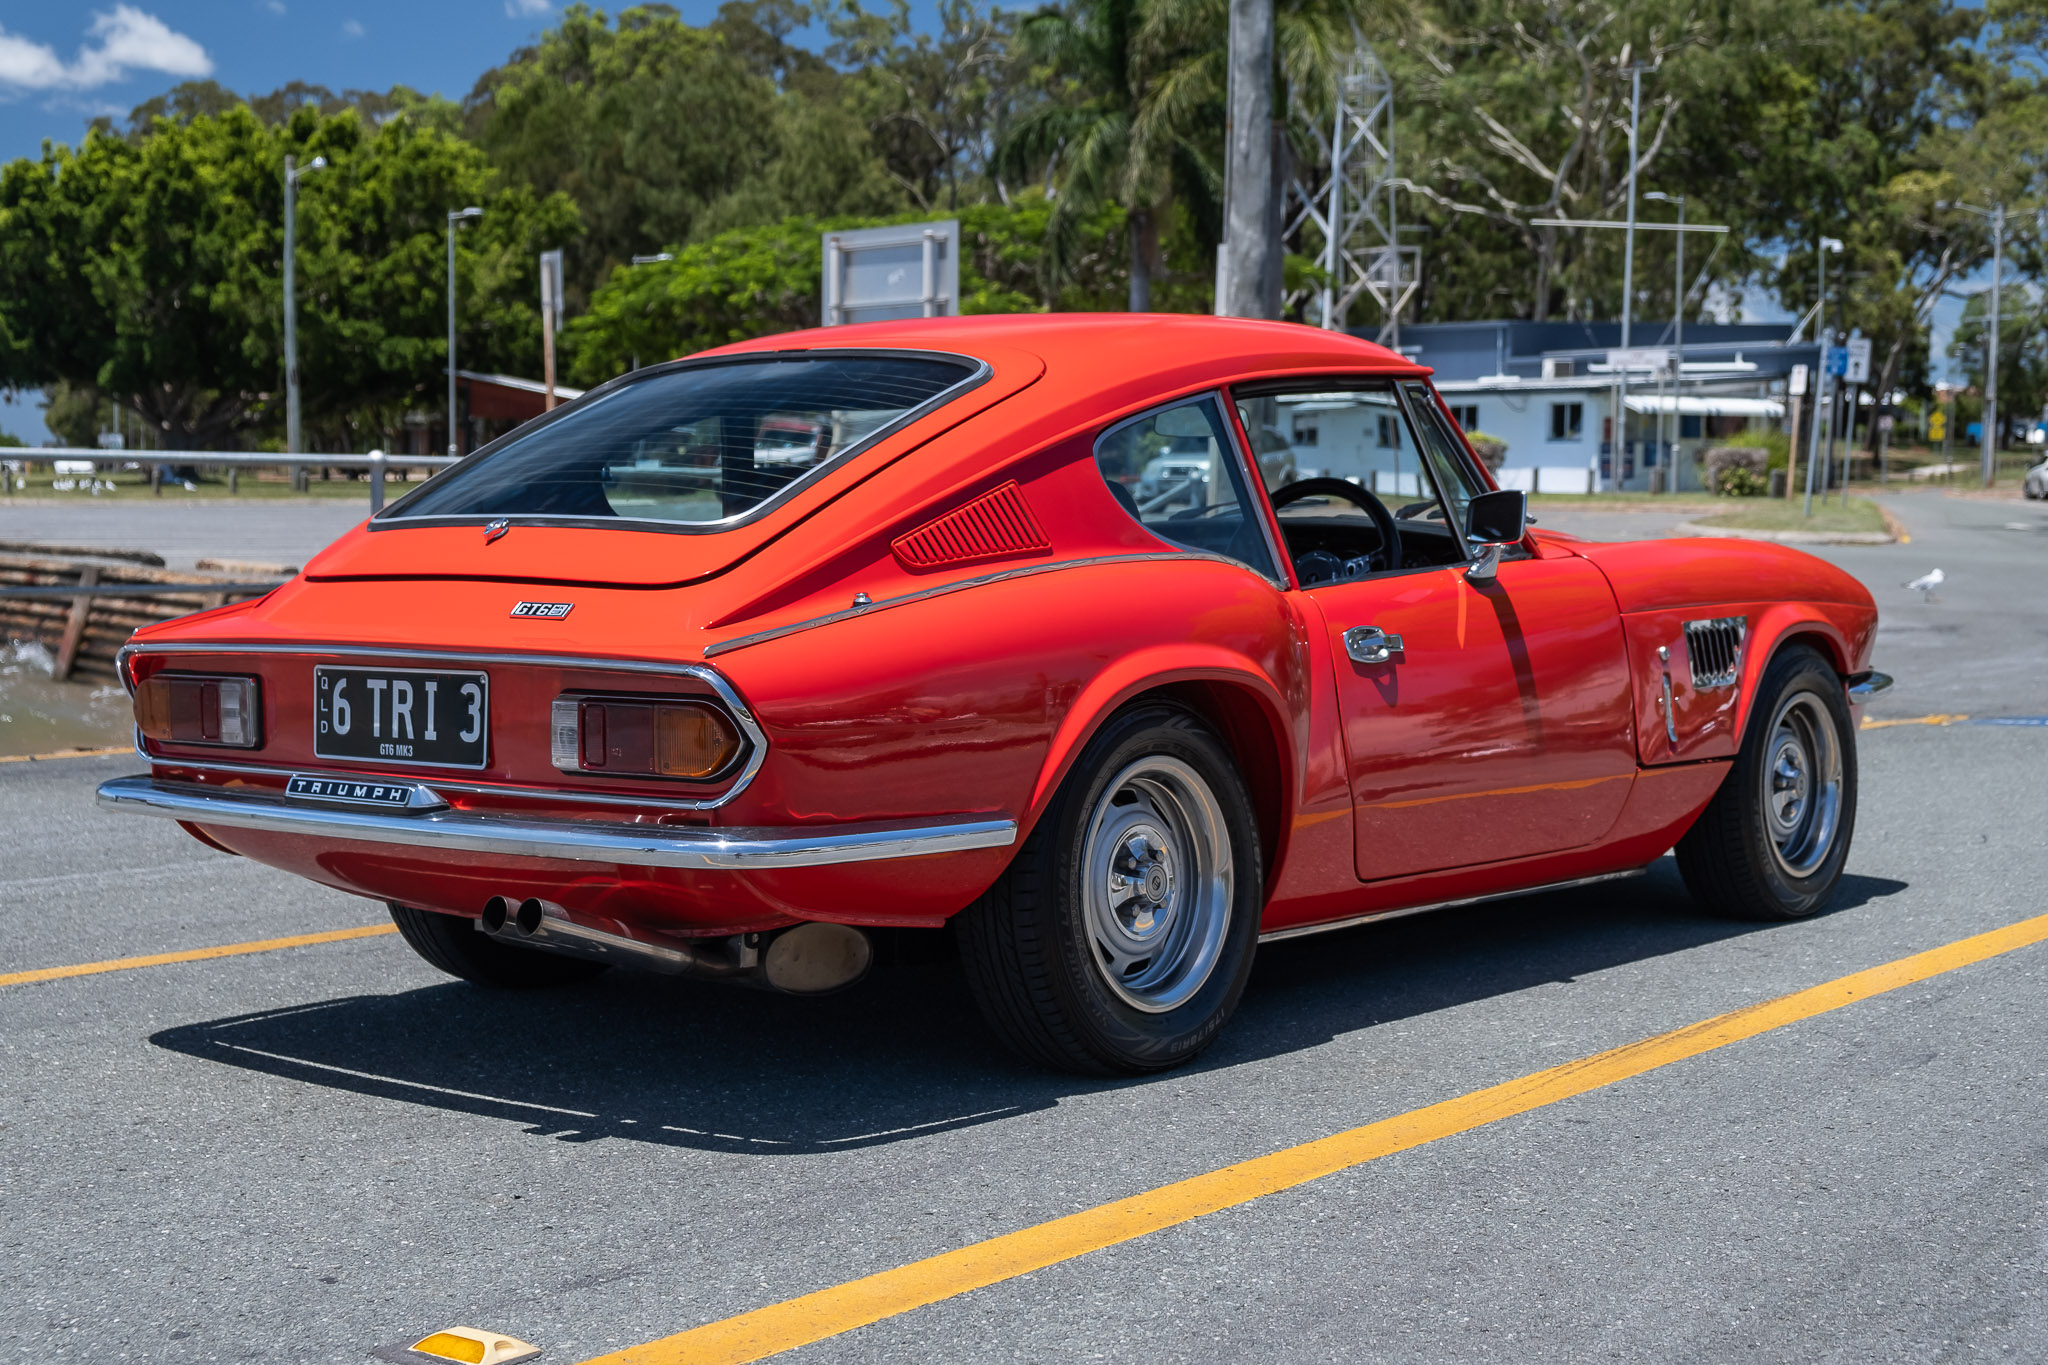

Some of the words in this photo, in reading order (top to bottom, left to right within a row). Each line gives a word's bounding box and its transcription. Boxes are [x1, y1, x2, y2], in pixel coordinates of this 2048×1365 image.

[514, 602, 553, 616] GT6
[320, 676, 329, 734] QLD
[332, 677, 351, 735] 6
[366, 678, 438, 741] TRI
[459, 682, 482, 743] 3
[379, 743, 394, 756] GT6
[396, 744, 413, 757] MK3
[296, 780, 402, 801] TRIUMPH
